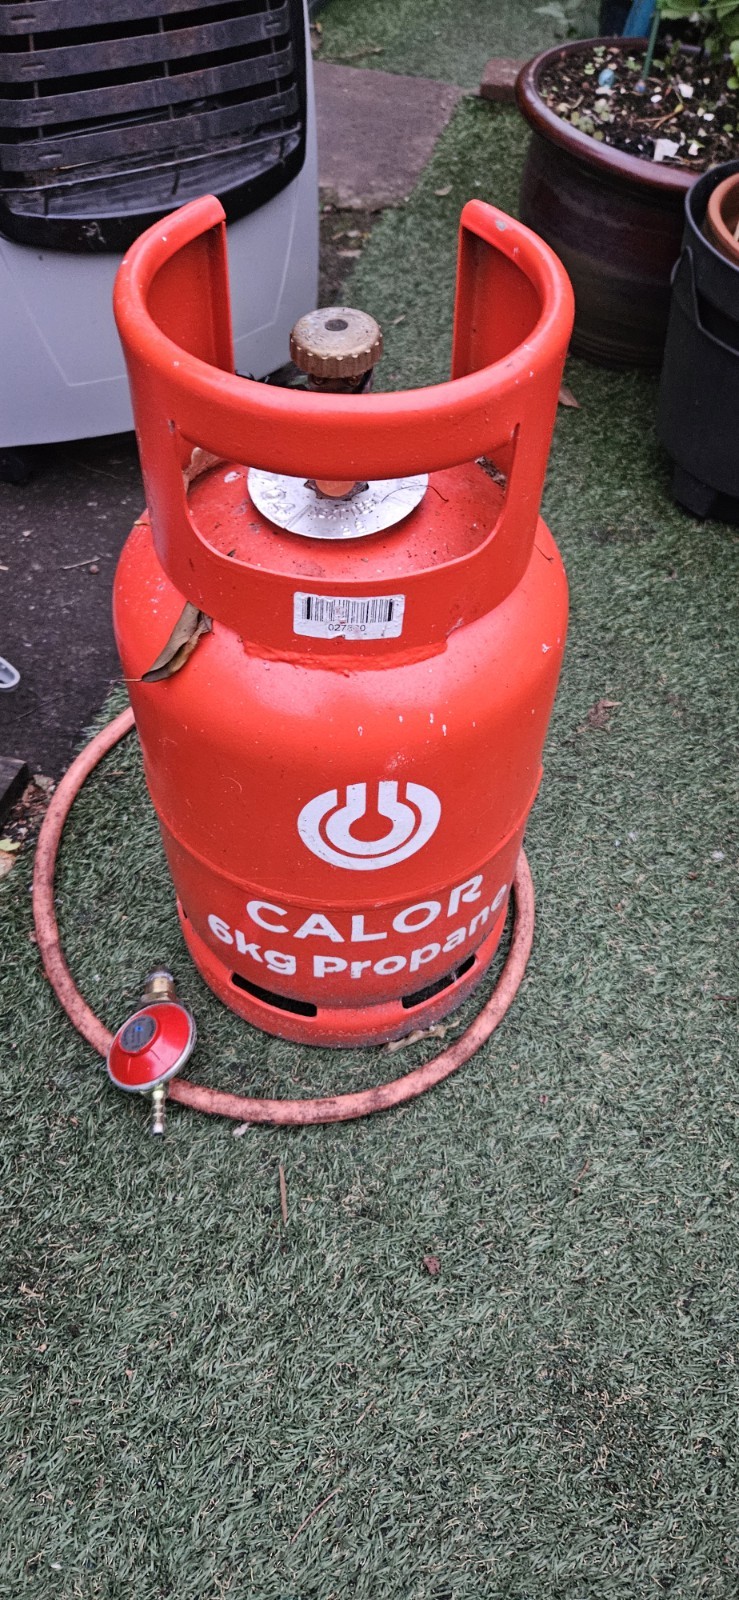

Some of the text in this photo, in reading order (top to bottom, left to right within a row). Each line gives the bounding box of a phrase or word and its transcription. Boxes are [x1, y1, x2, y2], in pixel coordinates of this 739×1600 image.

[207, 884, 507, 978] 6kg Propane
[246, 874, 483, 943] CALOR
